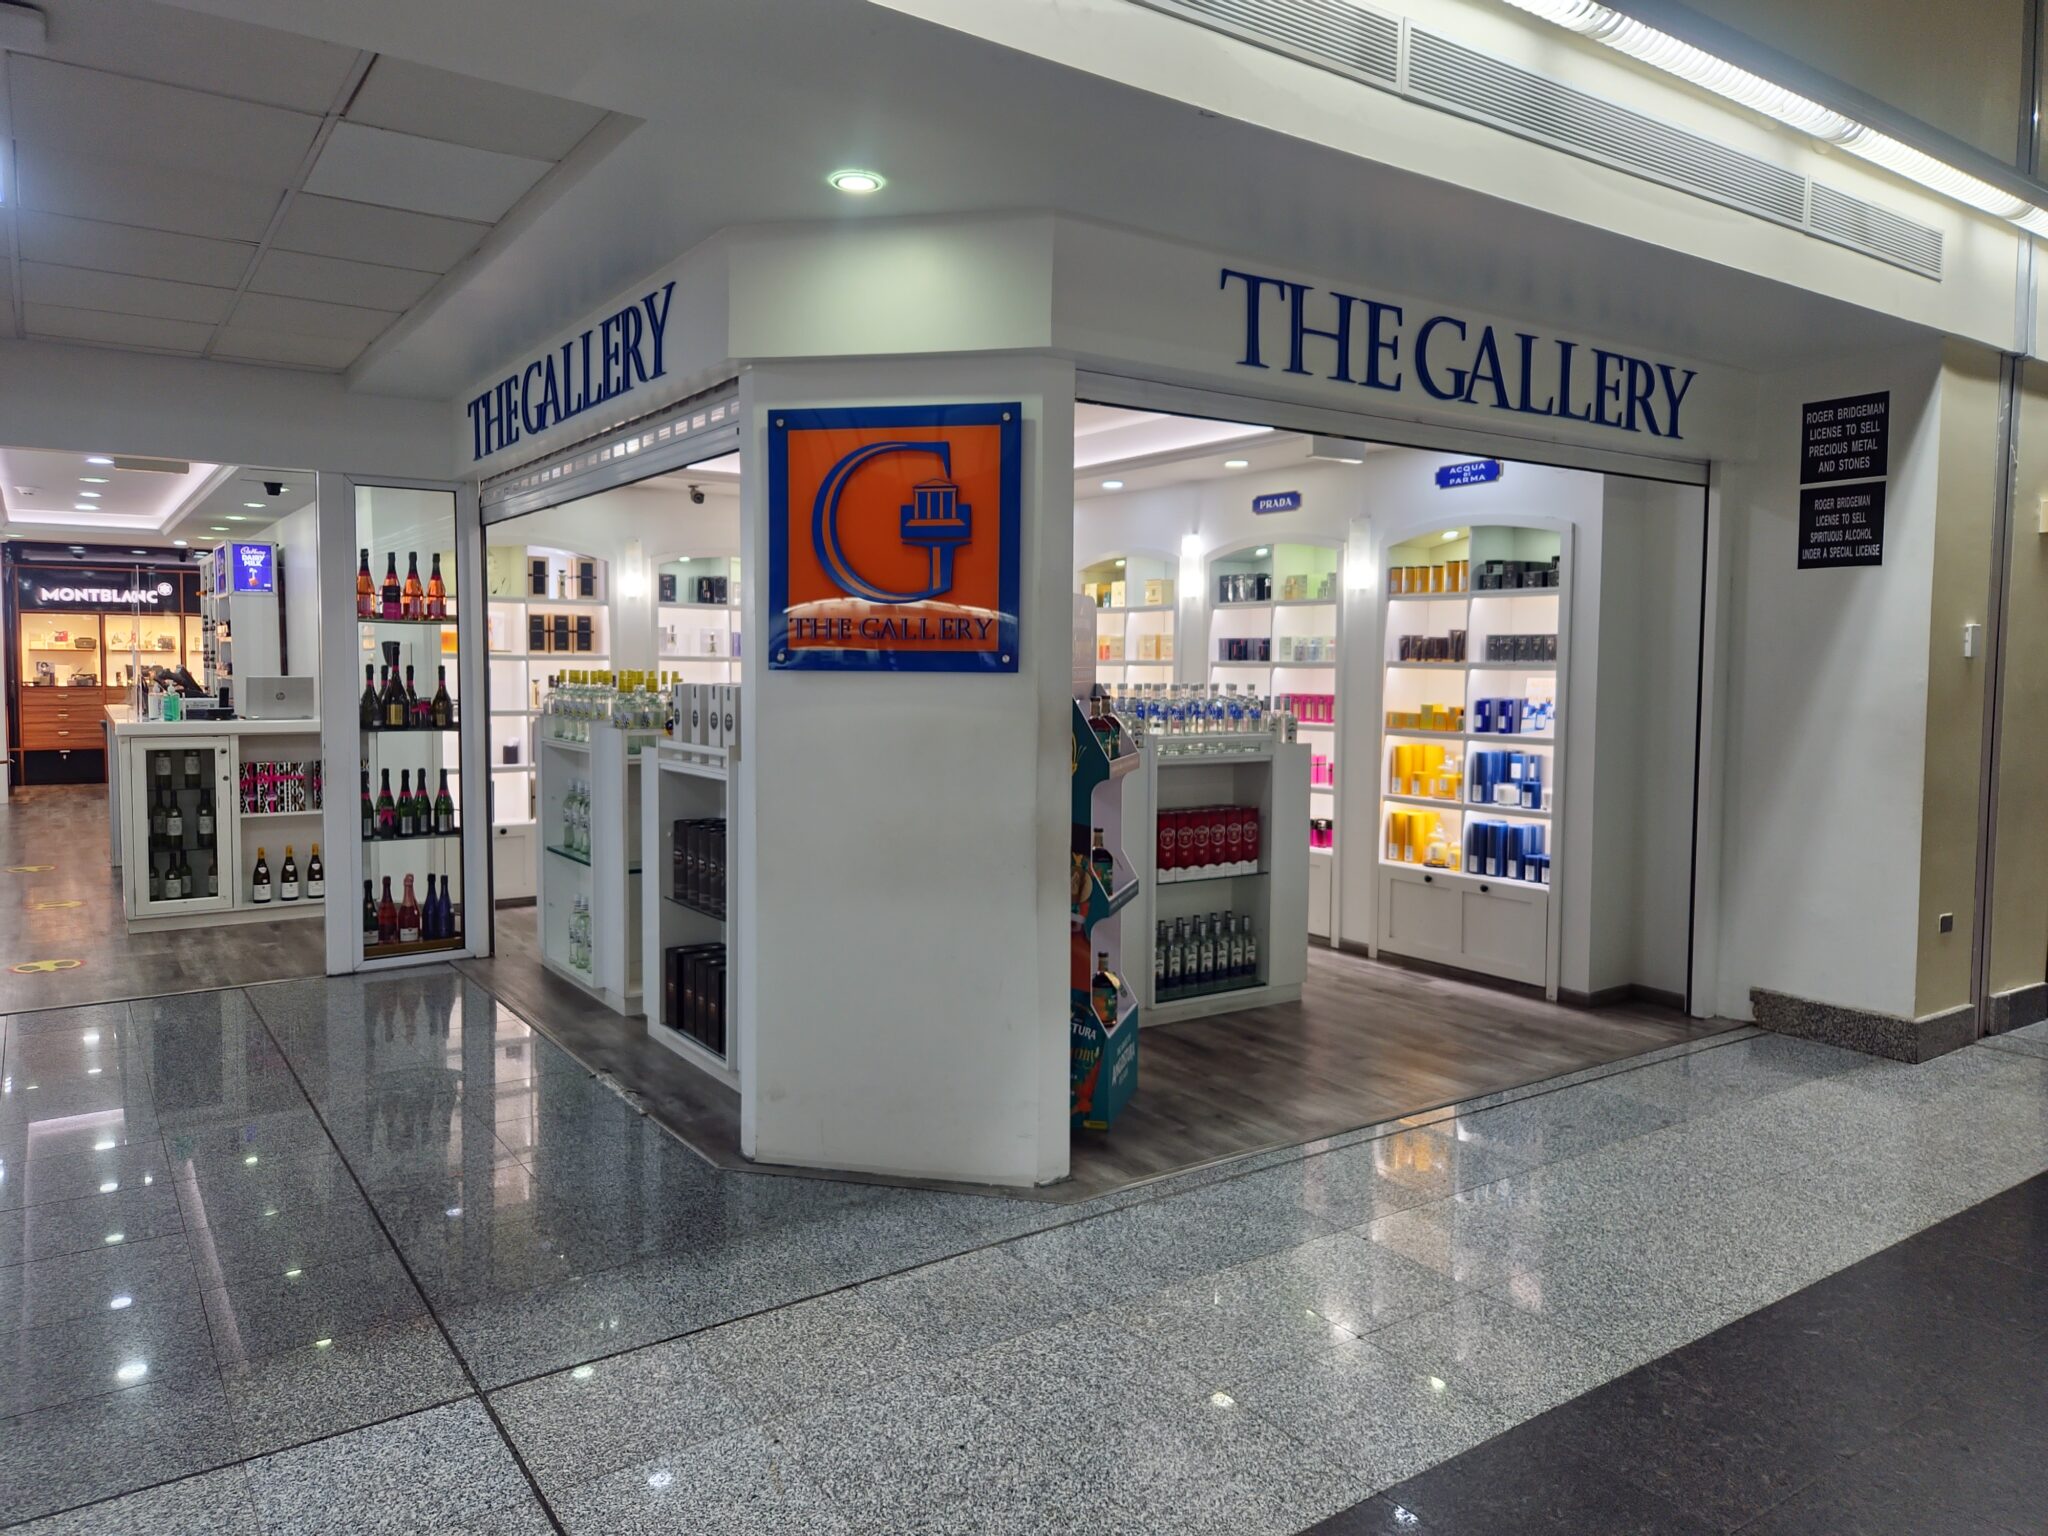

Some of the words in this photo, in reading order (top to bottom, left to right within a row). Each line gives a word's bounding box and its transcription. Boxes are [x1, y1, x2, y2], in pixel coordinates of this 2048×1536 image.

[1220, 267, 1403, 393] THE
[1414, 315, 1699, 440] GALLERY
[467, 374, 520, 462] THE
[521, 281, 677, 436] GALLERY
[1806, 409, 1834, 425] ROGER
[1837, 402, 1885, 420] BRIDGEMAN
[1809, 425, 1842, 441] LICENSE
[1846, 423, 1857, 436] TO
[1860, 420, 1881, 434] SELL
[1808, 441, 1848, 458] PRECIOUS
[1851, 438, 1878, 452] METAL
[1449, 463, 1486, 474] ACQUA
[1818, 460, 1836, 473] AND
[1838, 456, 1871, 471] STONES
[1449, 474, 1486, 485] PARMA
[1259, 497, 1292, 509] PRADA
[1814, 499, 1835, 510] ROGER
[1836, 495, 1871, 509] BRIDGEMAN
[1815, 514, 1840, 527] LICENSE
[1842, 513, 1850, 524] TO
[1852, 512, 1867, 524] SELL
[1810, 530, 1843, 543] SPIRITUOUS
[1844, 528, 1872, 541] ALCOHOL
[1802, 547, 1821, 560] UNDER
[1822, 547, 1828, 559] A
[1829, 546, 1853, 558] SPECIAL
[1855, 544, 1880, 556] LICENSE
[41, 587, 159, 604] MONTBLANC
[789, 617, 852, 640] THE
[859, 617, 993, 641] GALLERY
[1071, 1022, 1097, 1040] TURA
